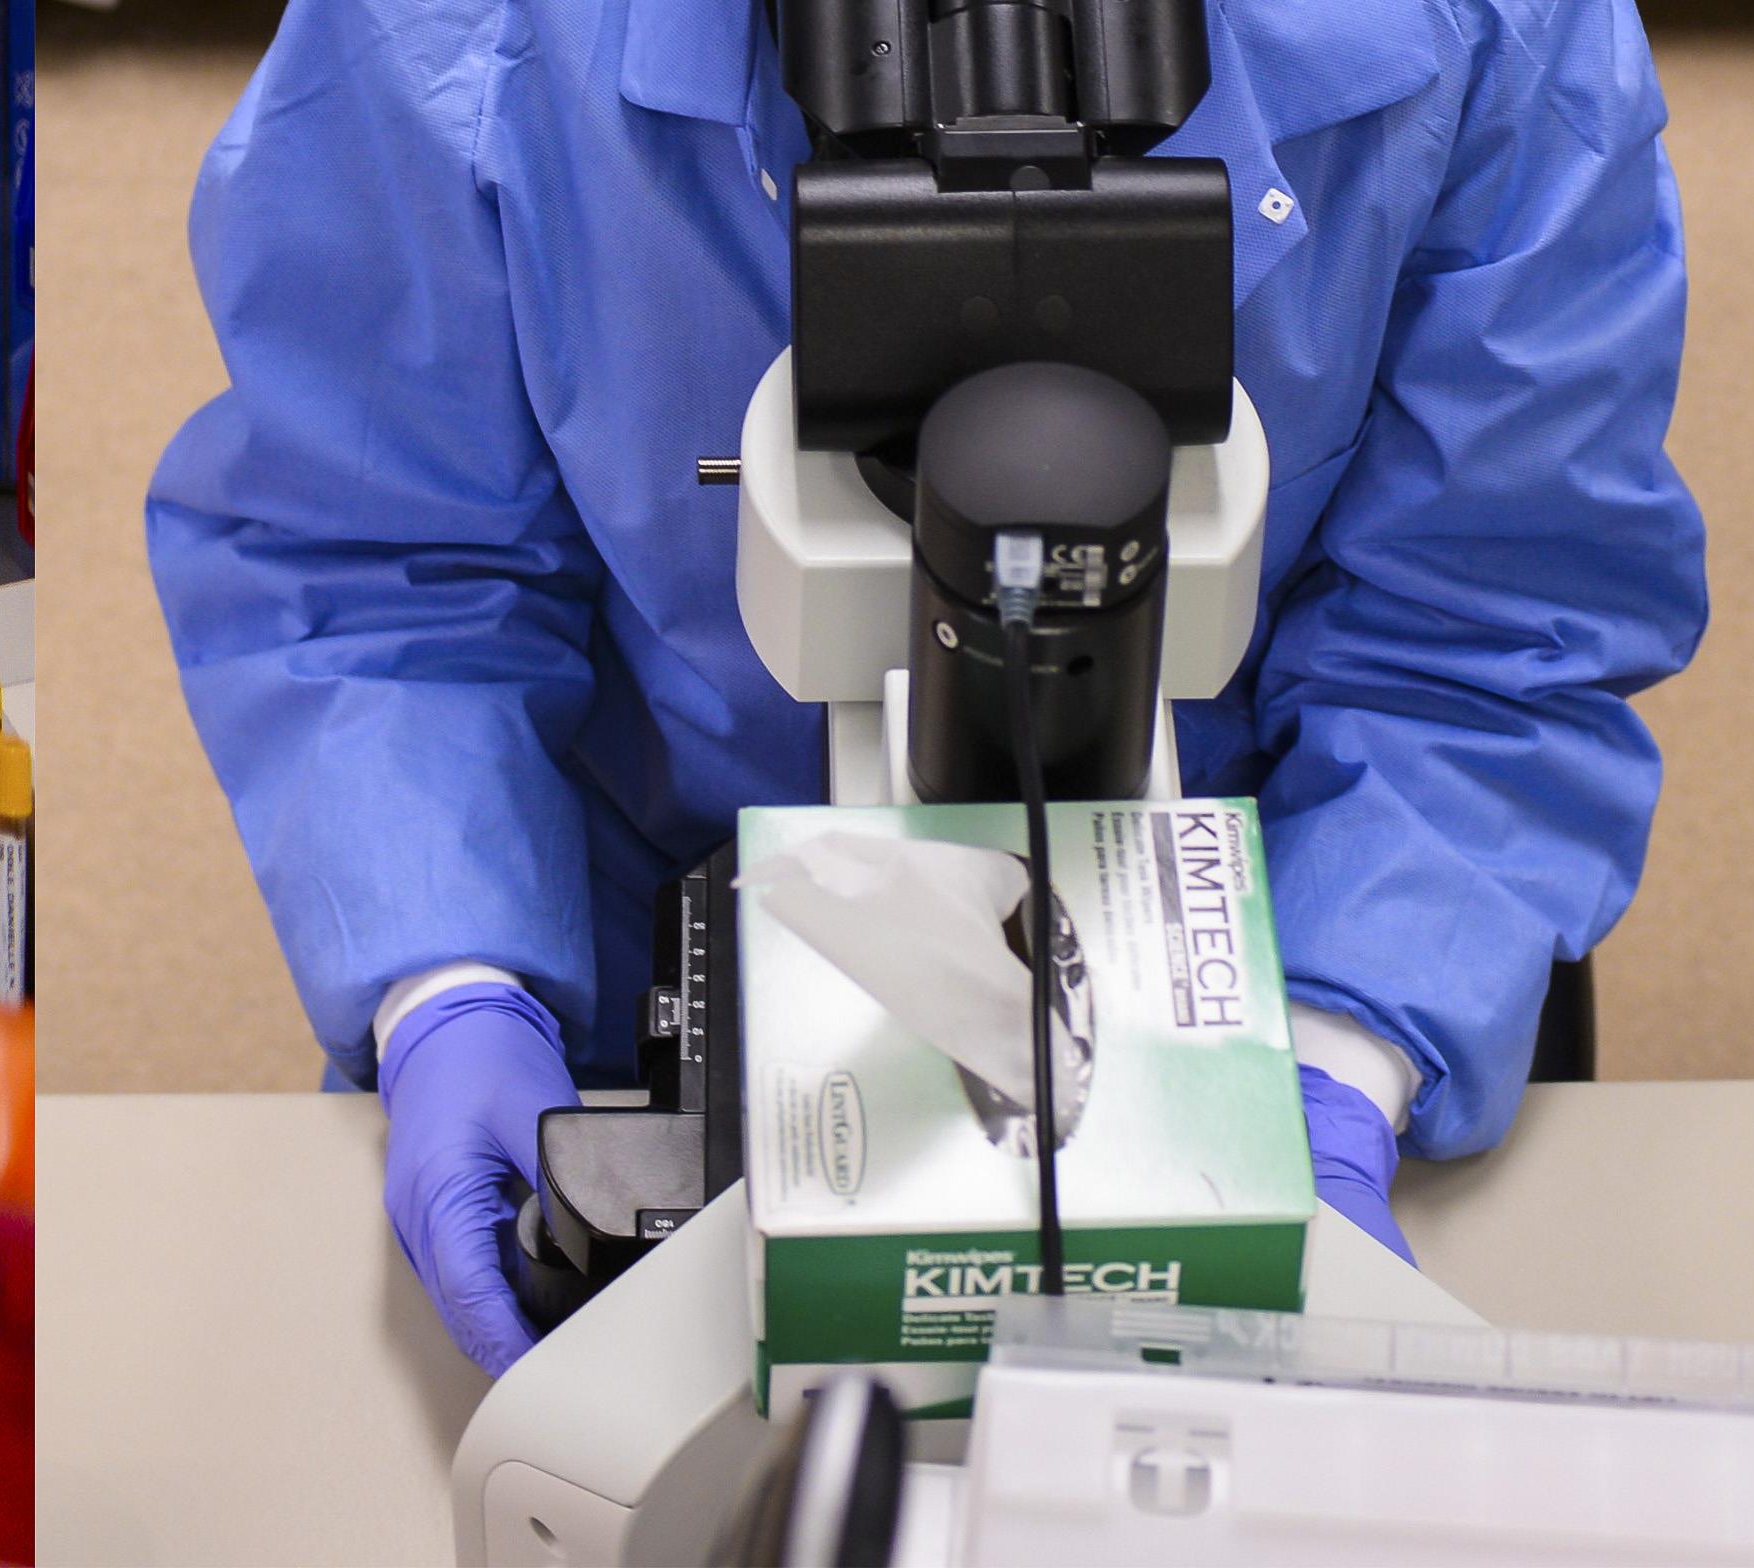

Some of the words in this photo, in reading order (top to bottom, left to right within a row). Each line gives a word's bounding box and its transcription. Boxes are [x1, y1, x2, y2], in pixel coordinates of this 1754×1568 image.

[1224, 811, 1249, 892] Kimwipes
[1176, 811, 1243, 1027] KIMTECH
[905, 1261, 1182, 1297] KIMTECH
[906, 1248, 1014, 1267] Kimwipes
